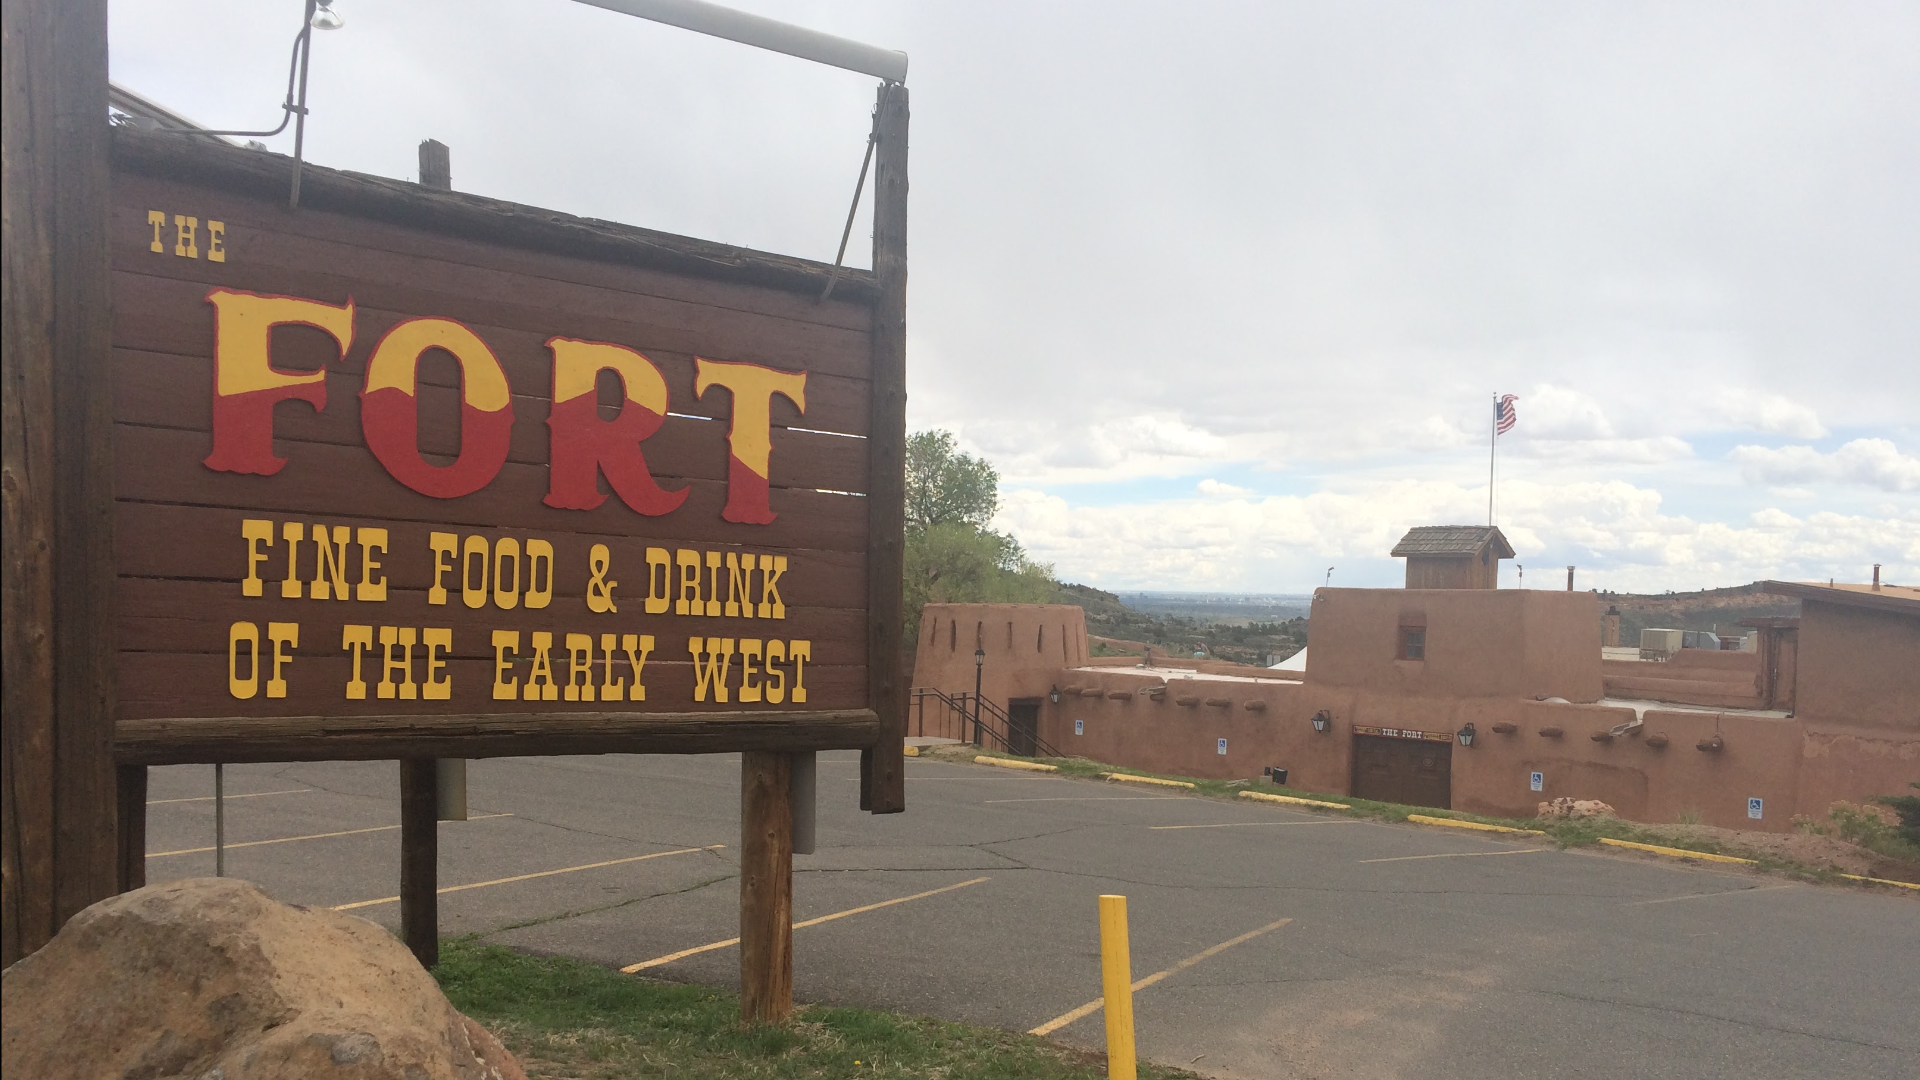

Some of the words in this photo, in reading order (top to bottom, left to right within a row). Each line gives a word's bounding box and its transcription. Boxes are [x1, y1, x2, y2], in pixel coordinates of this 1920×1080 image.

[148, 210, 225, 263] THE
[203, 286, 808, 525] FORT
[241, 519, 388, 602] FINE
[428, 531, 554, 610] FOOD
[586, 543, 618, 614] &
[644, 547, 788, 620] DRINK
[229, 621, 299, 699] OF
[342, 624, 452, 700] THE
[491, 629, 655, 702] EARLY
[688, 636, 811, 704] WEST
[1382, 728, 1398, 737] THE
[1402, 730, 1423, 739] FORT
